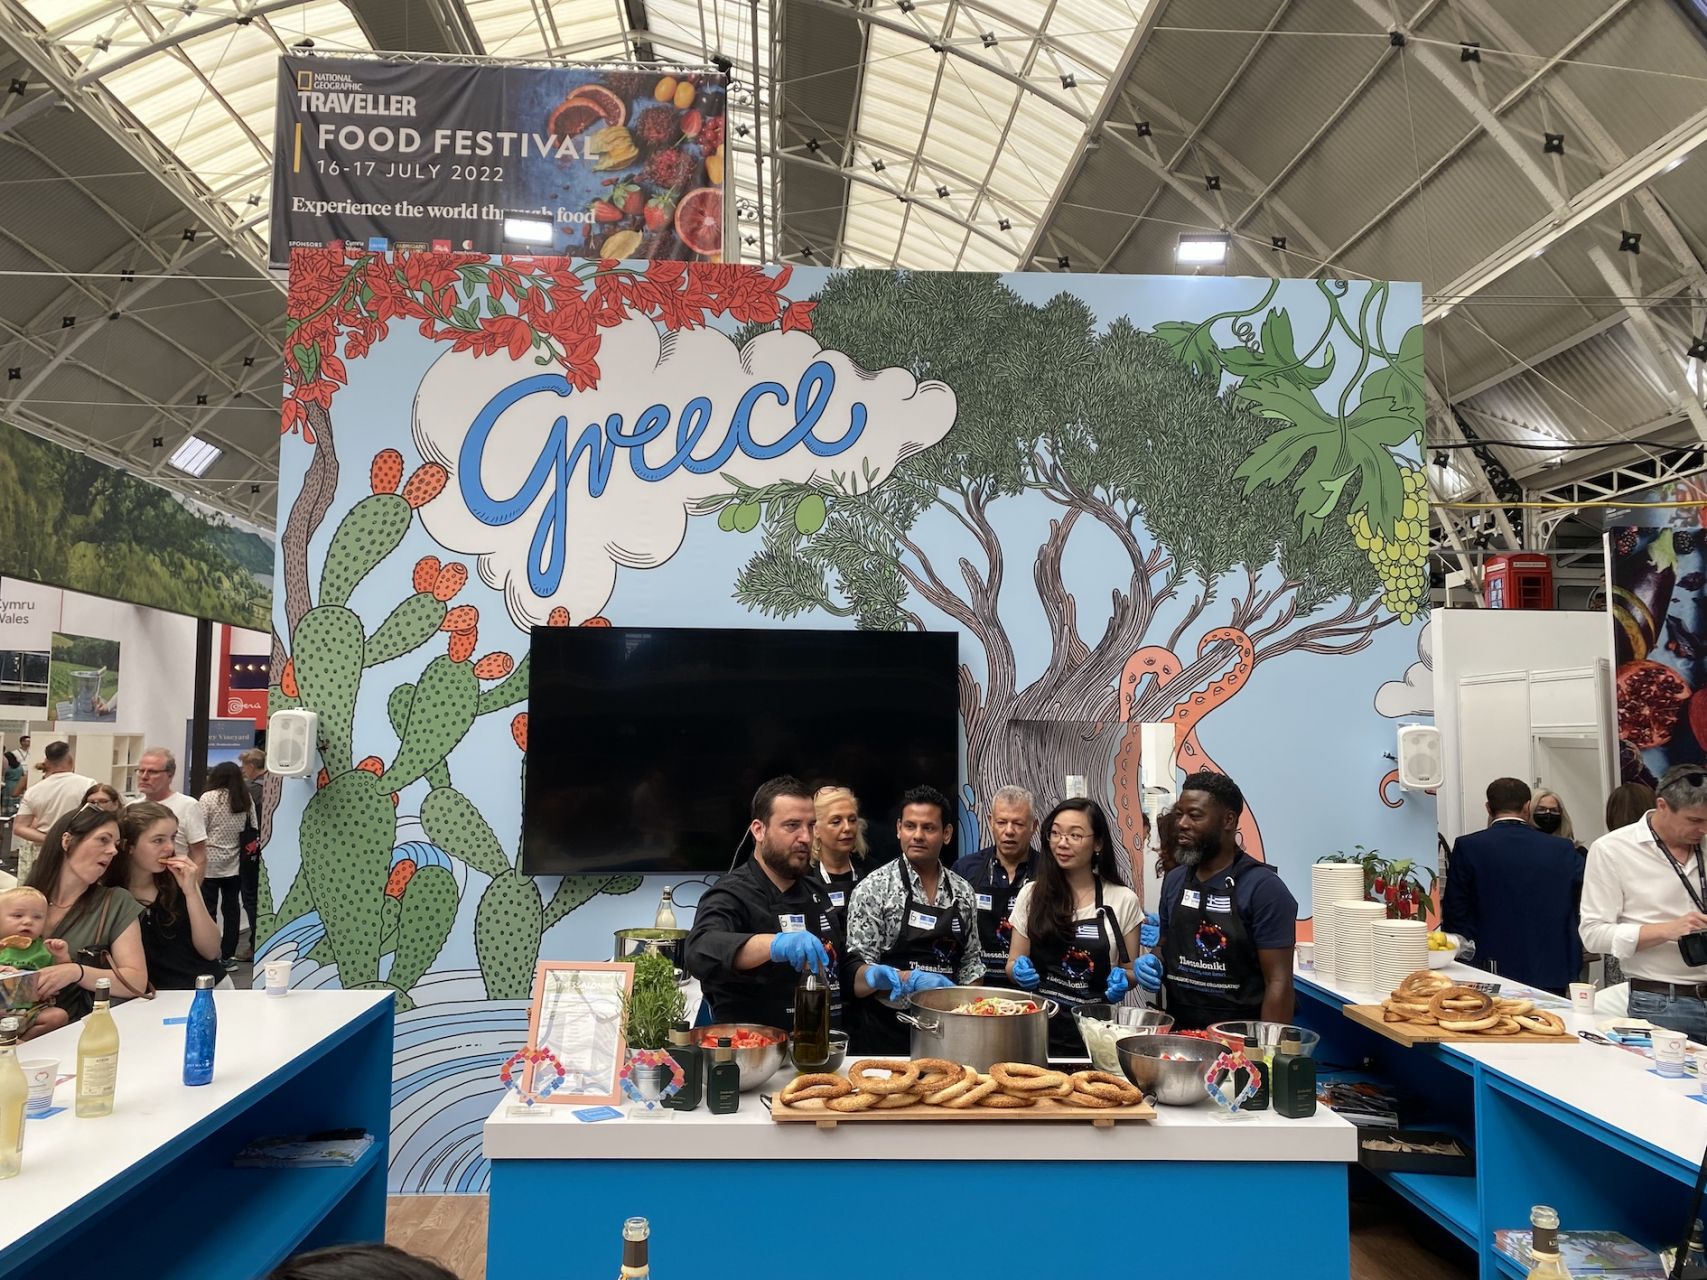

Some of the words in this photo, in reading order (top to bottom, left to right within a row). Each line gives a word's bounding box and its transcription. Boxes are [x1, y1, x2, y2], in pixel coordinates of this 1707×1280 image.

[314, 73, 352, 82] NATIONAL
[313, 81, 362, 91] GEOGRAPHIC
[298, 91, 417, 117] TRAVELLER
[318, 124, 421, 153] FOOD
[434, 129, 600, 160] FESTIVAL
[317, 160, 376, 177] 16-17
[386, 163, 441, 179] JULY
[451, 165, 504, 182] 2022
[291, 196, 392, 216] Experience
[395, 201, 424, 217] the
[427, 202, 478, 219] world
[557, 207, 596, 224] food
[289, 240, 323, 248] SPONSORS
[0, 601, 35, 612] ymru
[1179, 956, 1227, 971] Thessaloniki
